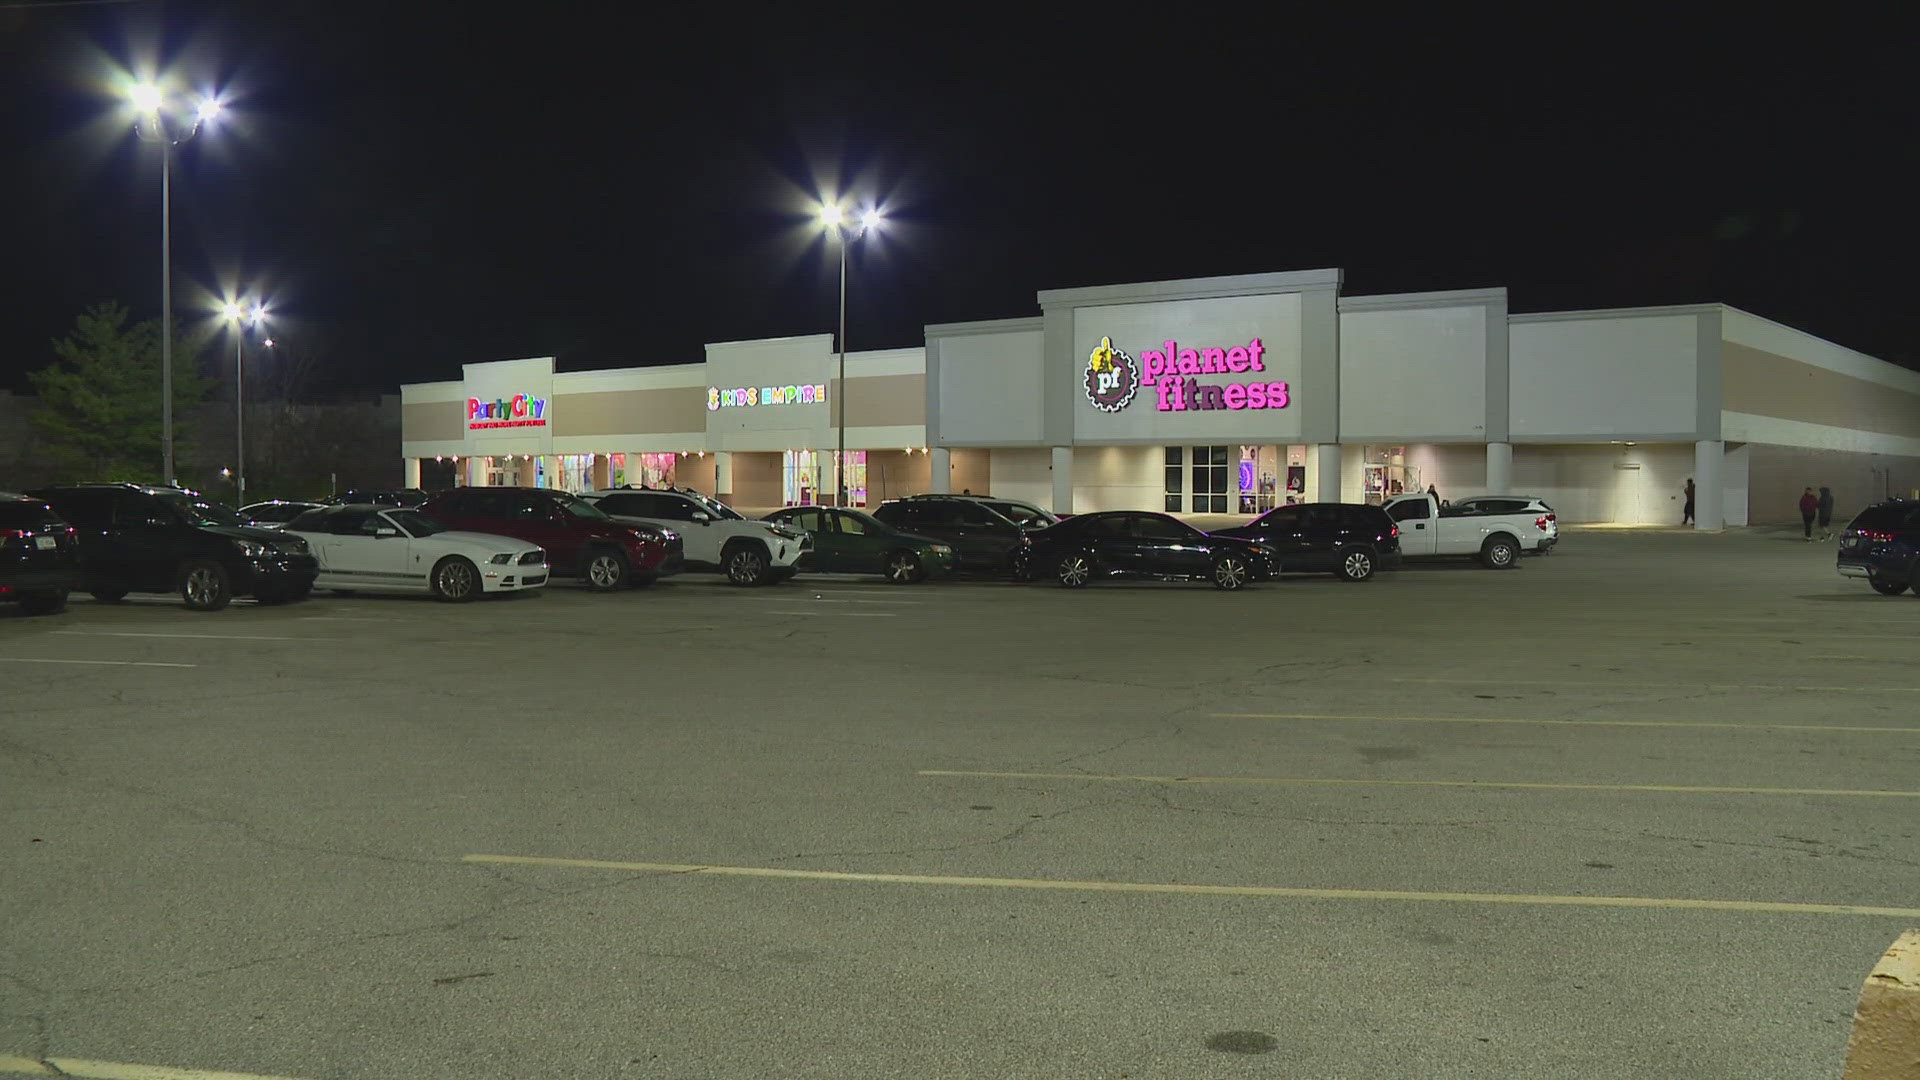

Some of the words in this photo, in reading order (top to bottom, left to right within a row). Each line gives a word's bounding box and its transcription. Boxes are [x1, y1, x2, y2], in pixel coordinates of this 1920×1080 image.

[1141, 338, 1264, 386] planet
[721, 387, 758, 407] KIDS
[761, 384, 825, 405] EMPIRE
[1097, 367, 1122, 394] pf
[1157, 376, 1289, 411] fitness
